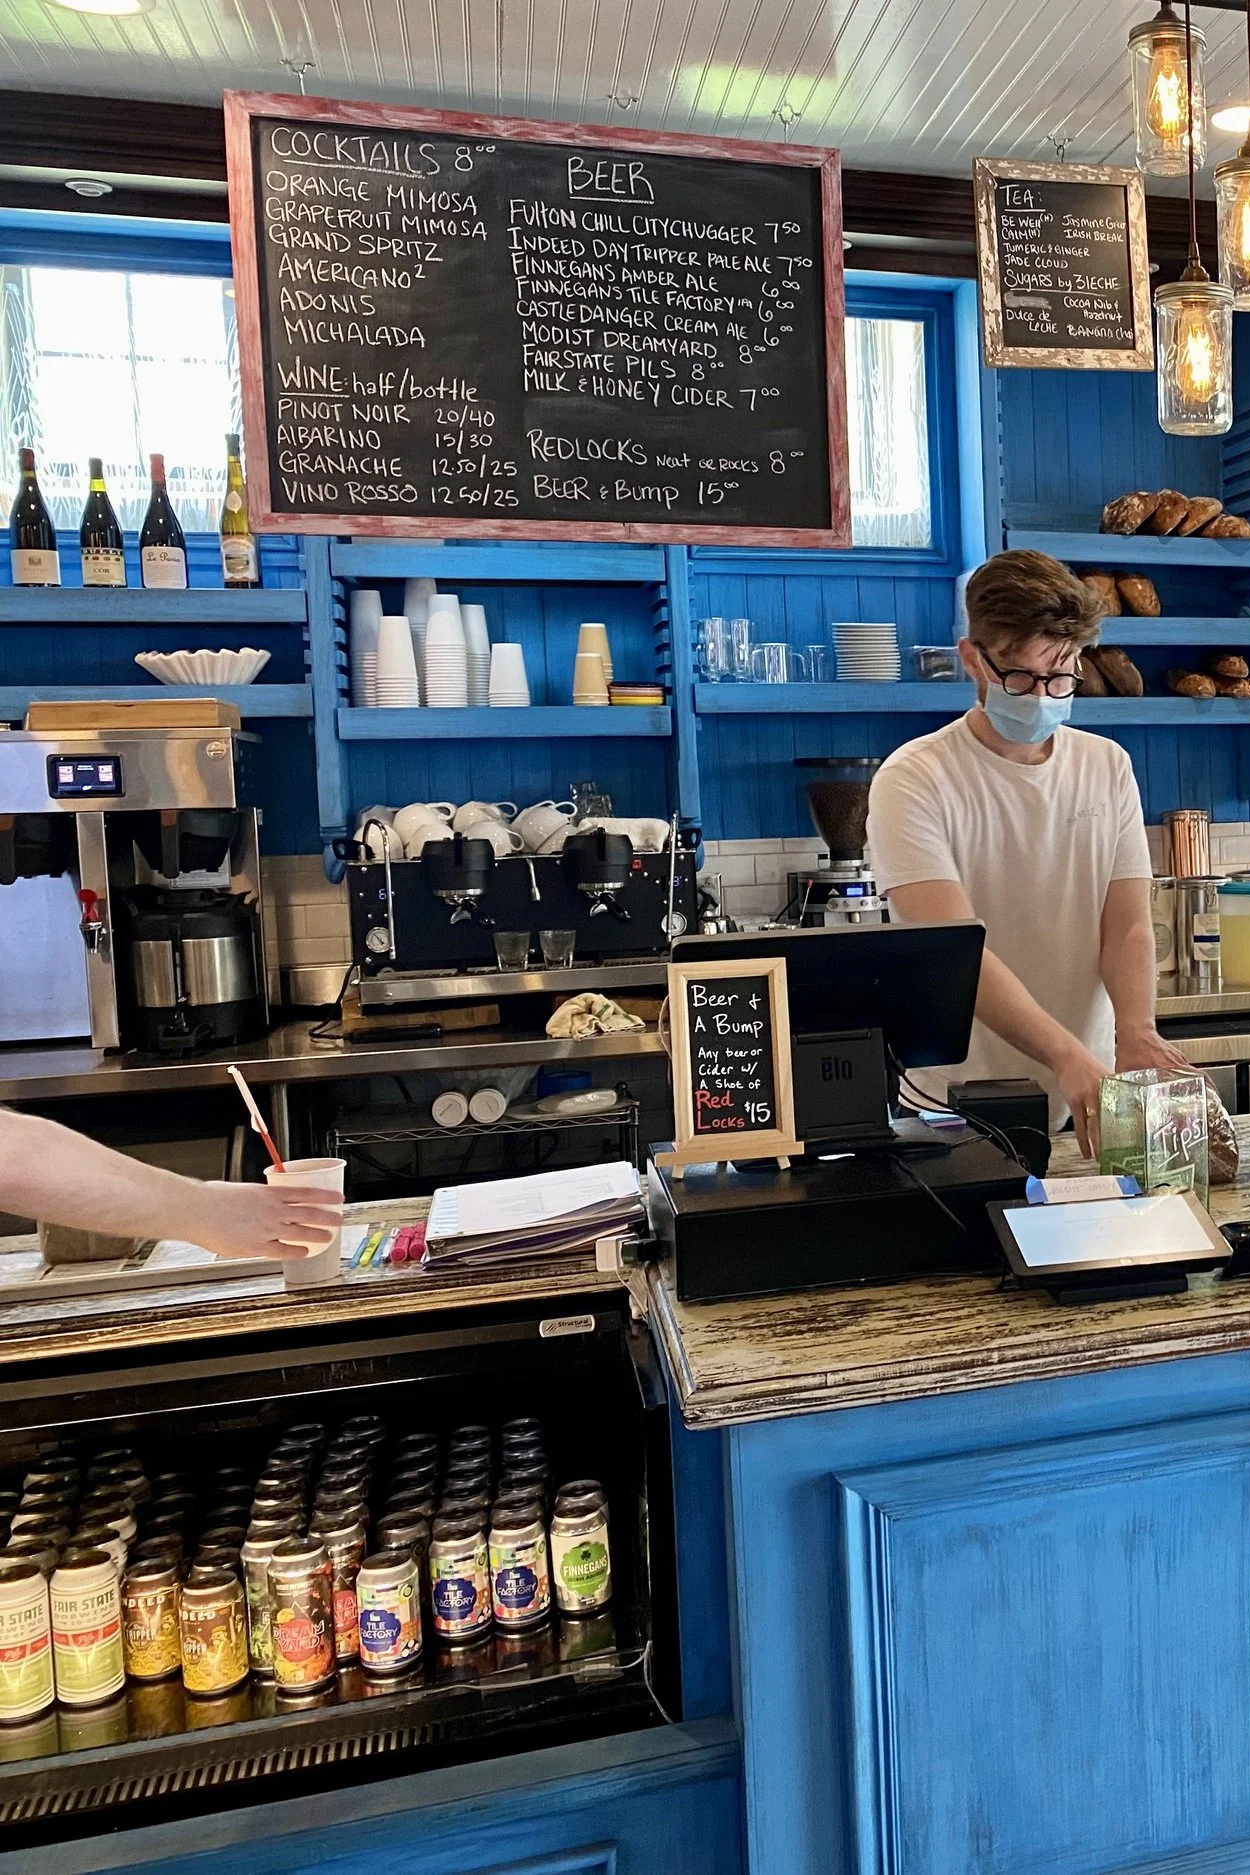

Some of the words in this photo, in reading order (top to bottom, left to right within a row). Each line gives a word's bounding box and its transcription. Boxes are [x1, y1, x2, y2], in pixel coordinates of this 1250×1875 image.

[271, 127, 441, 176] COCKTAILS
[567, 156, 655, 200] BEER
[266, 170, 371, 201] ORANGE
[386, 184, 477, 216] MIMOSA
[265, 197, 392, 230] GRAPEFRUIT
[402, 214, 488, 241] MIMOSA
[581, 211, 631, 233] CHILL
[1001, 214, 1016, 227] BE
[268, 223, 351, 253] GRAND
[358, 235, 443, 262] SPRITZ
[1002, 242, 1046, 254] TUMERIC
[1063, 229, 1092, 240] IRISH
[1093, 230, 1124, 242] BREAK
[507, 227, 585, 257] INDEED
[592, 239, 628, 263] DAY
[630, 244, 701, 266] TRIPPER
[707, 251, 741, 271] PALE
[1004, 253, 1030, 268] JADE
[1035, 256, 1069, 268] CLOUD
[511, 251, 615, 282] FINNEGANS
[622, 267, 680, 288] AMBER
[685, 273, 719, 292] ALE
[280, 286, 376, 316] ADONIS
[515, 276, 622, 300] FINNEGANS
[626, 286, 661, 305] TILE
[666, 291, 734, 314] FACTORY
[516, 300, 577, 322] CASTLE
[579, 305, 658, 330] DANGER
[664, 314, 719, 337] CREAM
[283, 316, 426, 348] MICHALADA
[522, 320, 595, 347] MODIST
[603, 331, 717, 359] DREAMYARD
[626, 355, 677, 379] PILS
[524, 368, 570, 392] MILK
[592, 375, 660, 407] HONEY
[671, 384, 734, 409] CIDER
[277, 399, 343, 421] PINOT
[352, 404, 410, 424] NOIR
[434, 405, 495, 428] 20/40
[435, 430, 493, 454] 15/30
[279, 450, 403, 477] GRANACHE
[281, 477, 338, 503] VINO
[344, 481, 418, 504] ROSSO
[533, 474, 591, 500] BEER
[691, 984, 738, 1008] Beer
[694, 1015, 706, 1033] A
[712, 1013, 764, 1039] Bump
[698, 1047, 719, 1063] Any
[726, 1047, 749, 1058] beer
[750, 1048, 763, 1057] or
[698, 1063, 734, 1076] Cider
[741, 1062, 758, 1076] w/
[700, 1080, 708, 1090] A
[716, 1078, 744, 1090] Shot
[748, 1078, 761, 1090] of
[695, 1089, 735, 1110] Red
[744, 1101, 771, 1124] $15
[444, 1590, 463, 1599] TILE
[497, 1582, 536, 1596] FACTORY
[505, 1578, 525, 1588] TILE
[54, 1600, 78, 1613] FAIR
[81, 1588, 114, 1611] STATE
[9, 1603, 43, 1625] STATE
[367, 1621, 386, 1630] TILE
